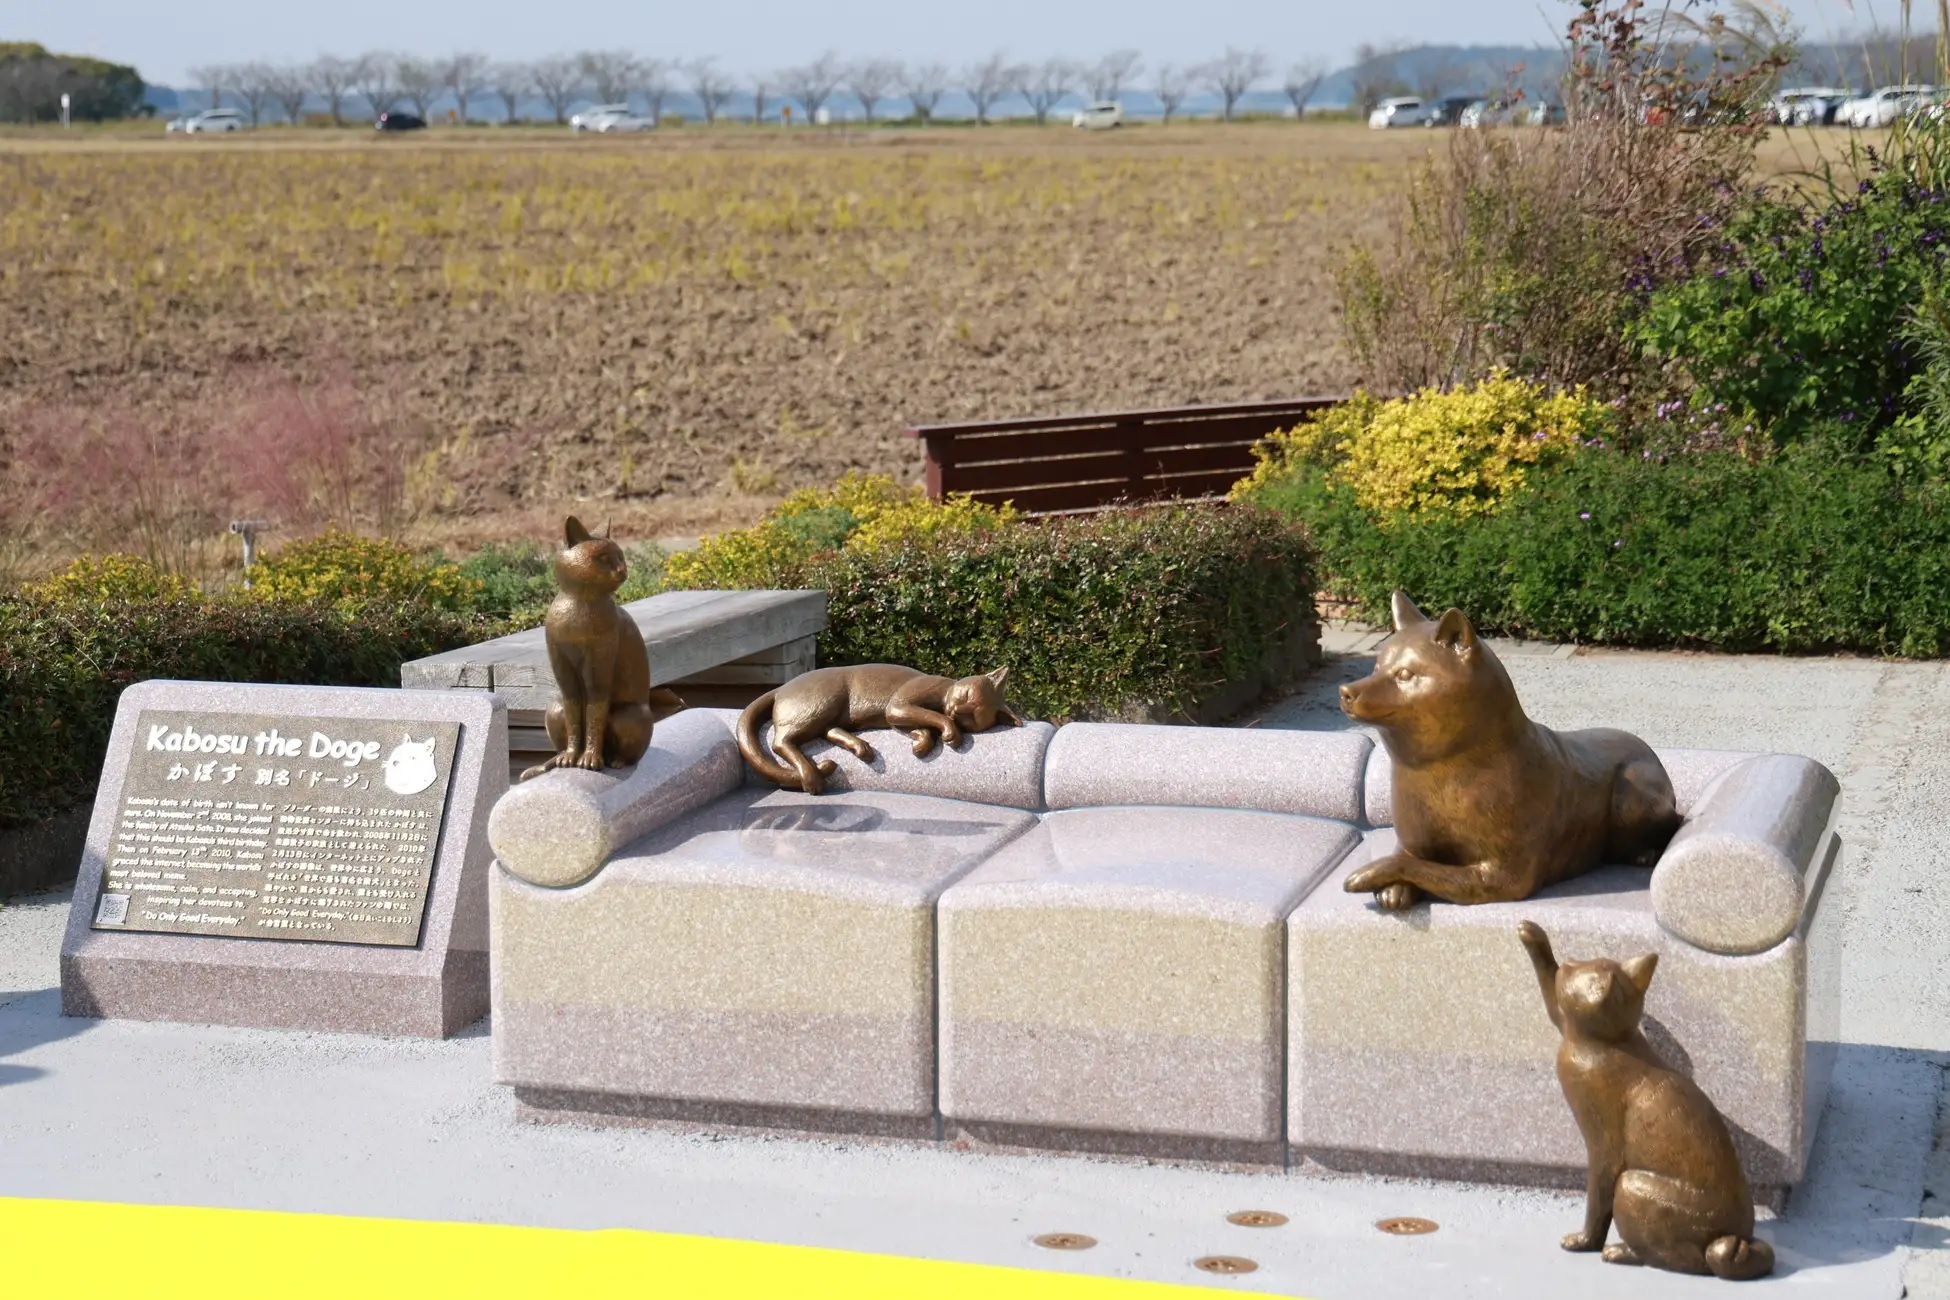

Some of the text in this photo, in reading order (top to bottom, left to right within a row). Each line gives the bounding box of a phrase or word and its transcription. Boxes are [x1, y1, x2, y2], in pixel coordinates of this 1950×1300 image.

[147, 724, 381, 767] Kabosu the Doge
[167, 760, 243, 785] かぼす
[161, 798, 179, 806] date
[181, 798, 192, 808] of
[194, 800, 214, 808] birth
[262, 802, 276, 811] for
[144, 809, 156, 817] On
[234, 813, 248, 822] she
[248, 815, 273, 824] joined
[122, 821, 135, 829] the
[135, 821, 159, 832] family
[160, 822, 170, 831] of
[168, 823, 196, 831] Atsuko
[215, 825, 224, 833] It
[240, 826, 271, 835] decided
[119, 833, 135, 841] that
[136, 833, 151, 842] this
[151, 834, 176, 843] should
[217, 837, 236, 846] third
[117, 844, 136, 853] Then
[152, 846, 188, 858] February
[211, 849, 233, 859] 2010,
[236, 850, 265, 860] Kabosu
[112, 857, 140, 867] graced
[140, 858, 154, 866] the
[186, 860, 222, 872] becoming
[222, 862, 236, 870] the
[131, 870, 162, 879] beloved
[108, 881, 123, 889] She
[124, 882, 133, 890] is
[202, 886, 218, 894] and
[182, 897, 197, 905] her
[198, 898, 234, 908] devotees
[159, 911, 179, 923] Only
[179, 913, 201, 922] Good
[273, 908, 290, 918] Only
[290, 909, 310, 917] Good
